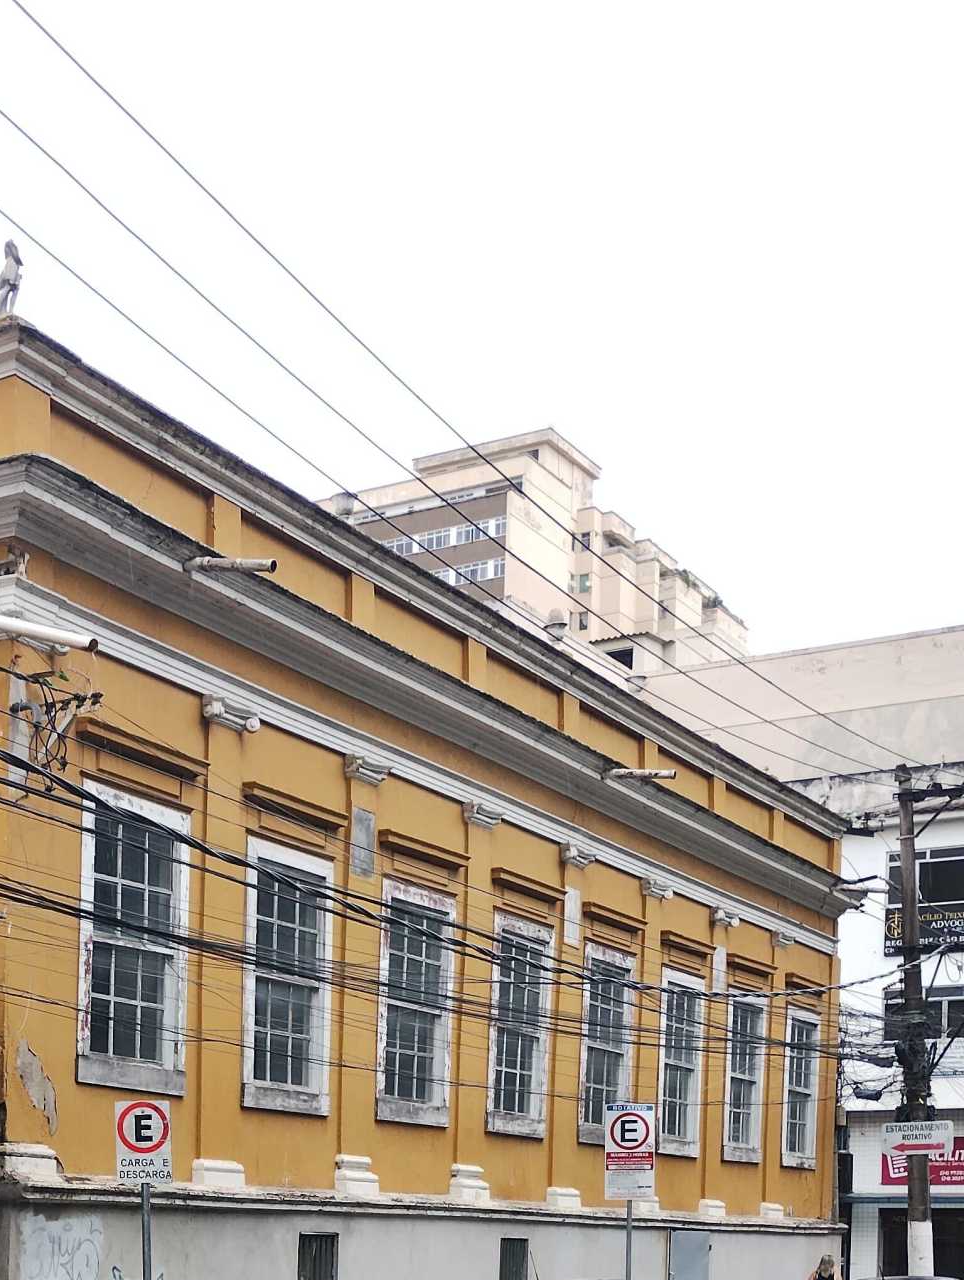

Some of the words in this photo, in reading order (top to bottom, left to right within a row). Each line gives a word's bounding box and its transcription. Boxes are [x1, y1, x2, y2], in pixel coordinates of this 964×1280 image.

[134, 1114, 153, 1142] E
[620, 1120, 639, 1143] E
[886, 1123, 948, 1133] ESTACIONAMENTO
[120, 1158, 155, 1168] CARGA
[162, 1158, 169, 1167] E
[119, 1170, 172, 1180] DESCARGA
